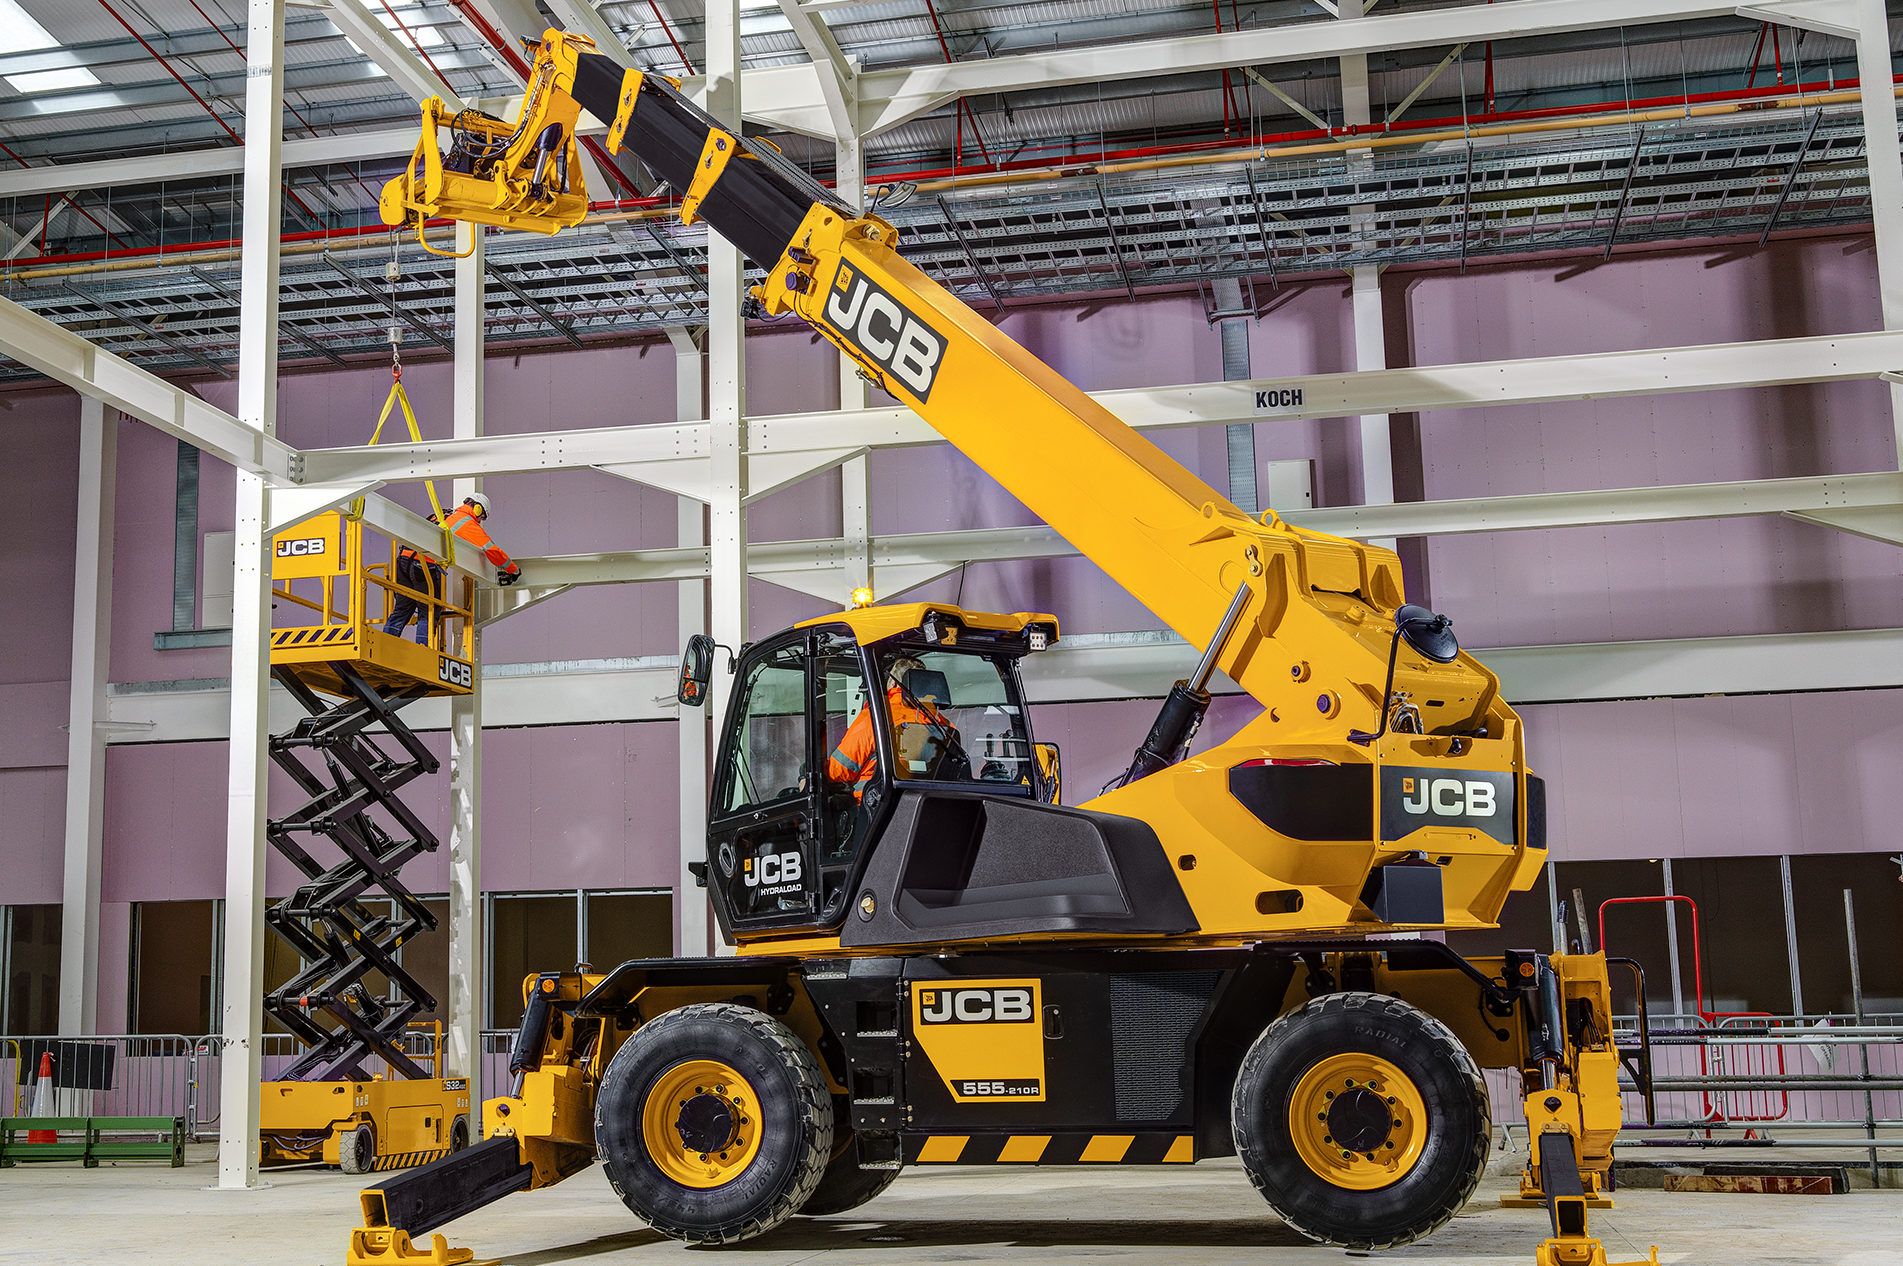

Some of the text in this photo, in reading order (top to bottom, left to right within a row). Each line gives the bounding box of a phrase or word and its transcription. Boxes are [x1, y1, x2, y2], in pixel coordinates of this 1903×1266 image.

[828, 278, 940, 393] JCB
[1255, 389, 1303, 408] KOCH
[277, 539, 325, 557] JCB
[439, 658, 472, 688] JCB
[1403, 778, 1497, 817] JCB
[744, 851, 802, 888] JCB
[760, 883, 802, 897] HYDRALOAD
[922, 989, 1032, 1022] JCB
